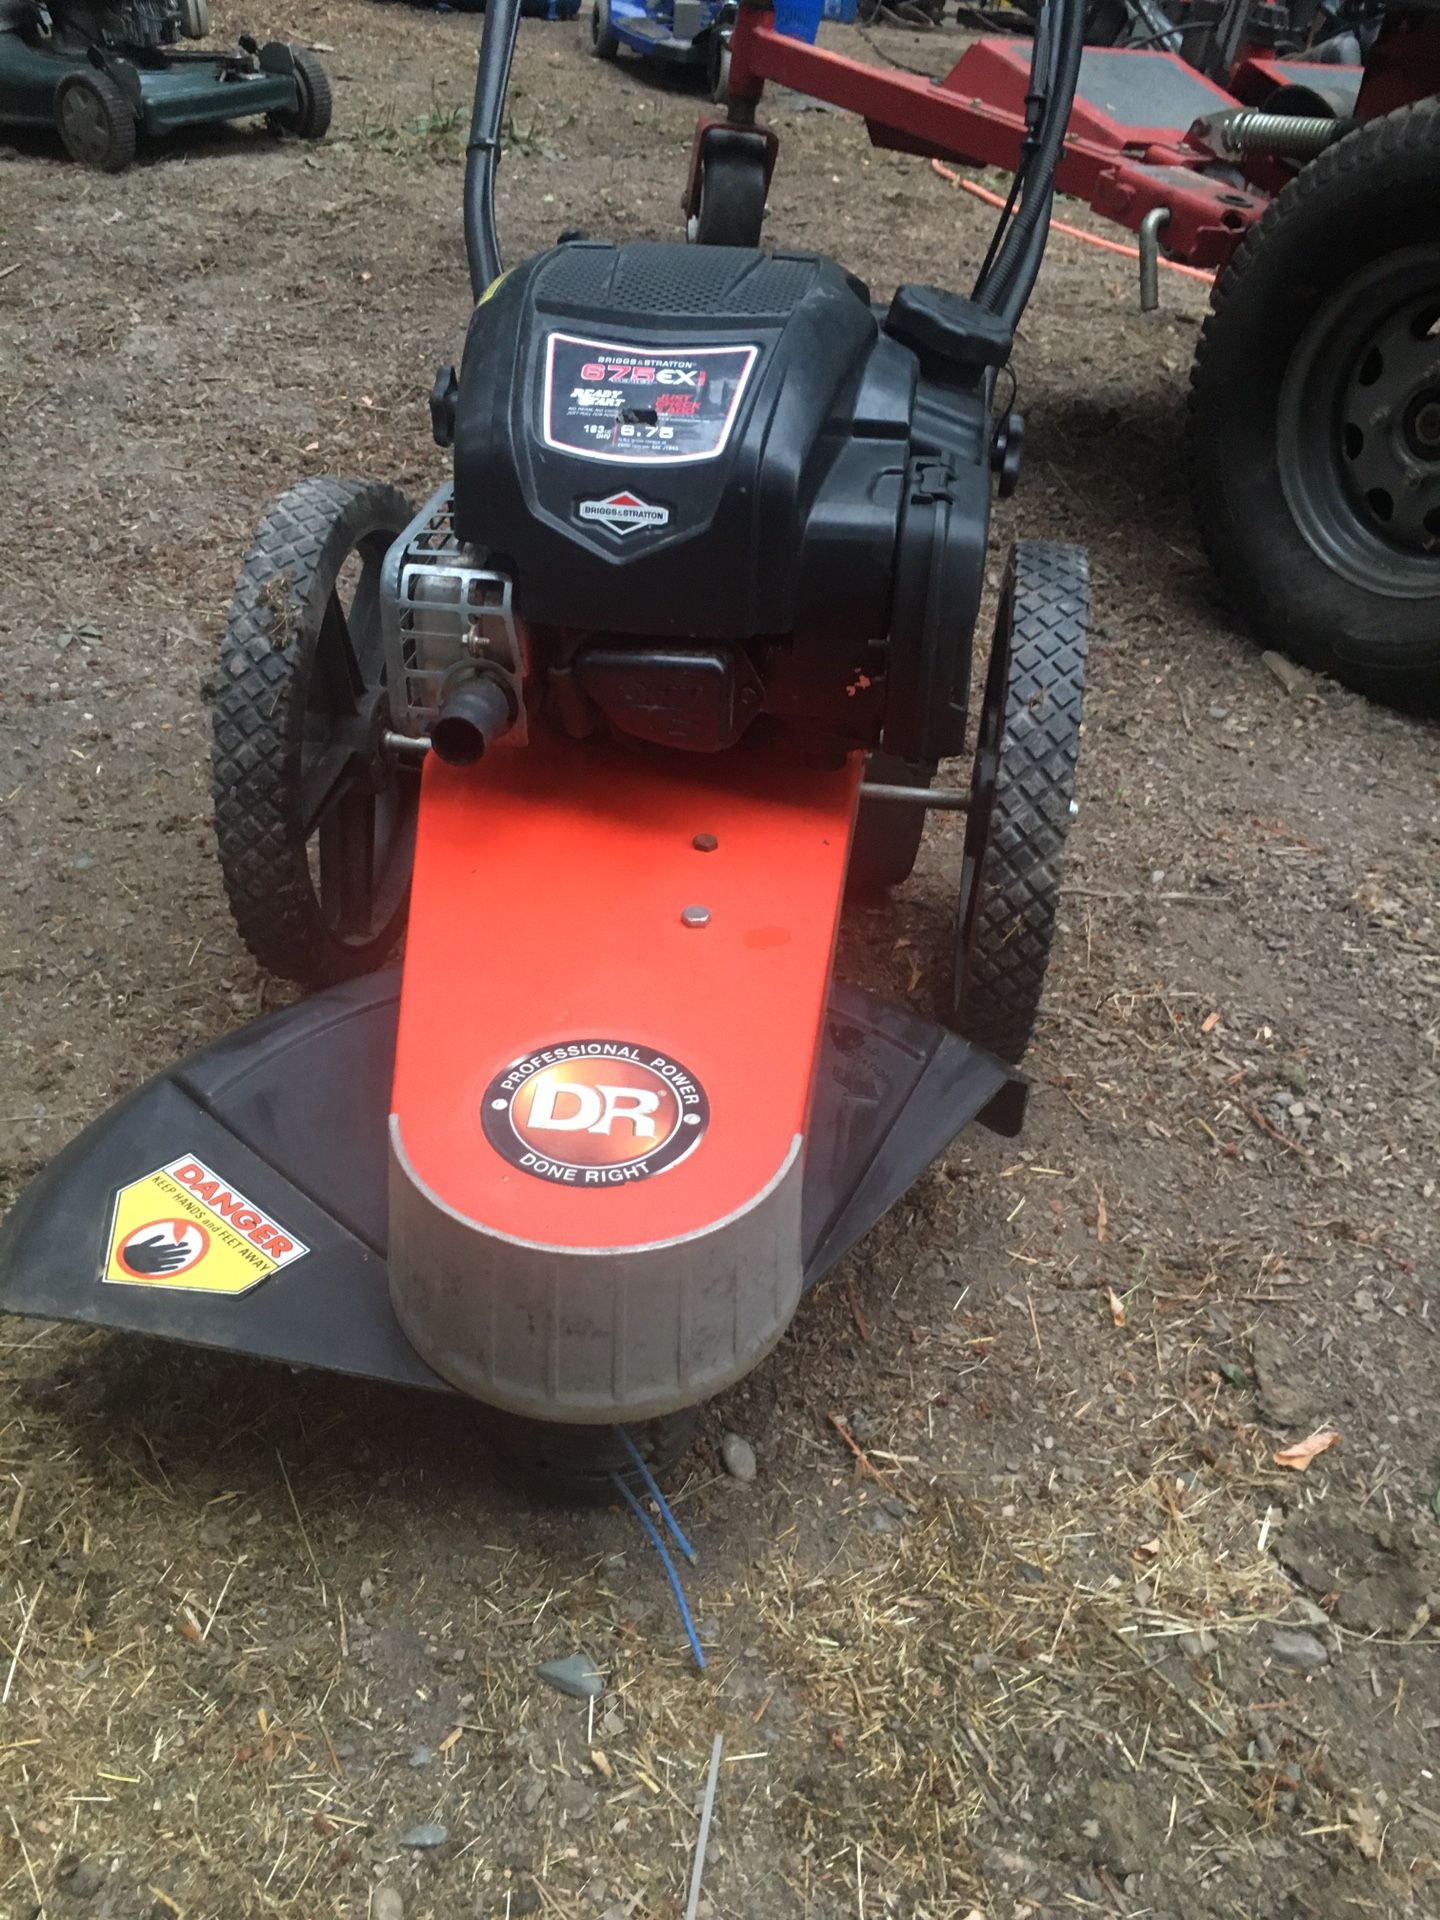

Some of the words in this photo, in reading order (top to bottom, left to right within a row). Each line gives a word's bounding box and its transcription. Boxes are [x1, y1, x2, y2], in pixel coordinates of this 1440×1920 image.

[570, 388, 623, 399] READY
[621, 425, 674, 439] 6.75
[501, 1043, 641, 1091] PROFESSIONAL
[650, 1057, 700, 1105] POWER
[527, 1082, 660, 1138] DR
[519, 1153, 577, 1182] DONE
[585, 1161, 650, 1183] RIGHT
[151, 1175, 177, 1199] KEEP
[173, 1191, 206, 1220] HANDS
[201, 1217, 220, 1233] and
[218, 1230, 243, 1254] FEET
[238, 1248, 271, 1272] AWAY
[173, 1163, 294, 1259] DANGER
